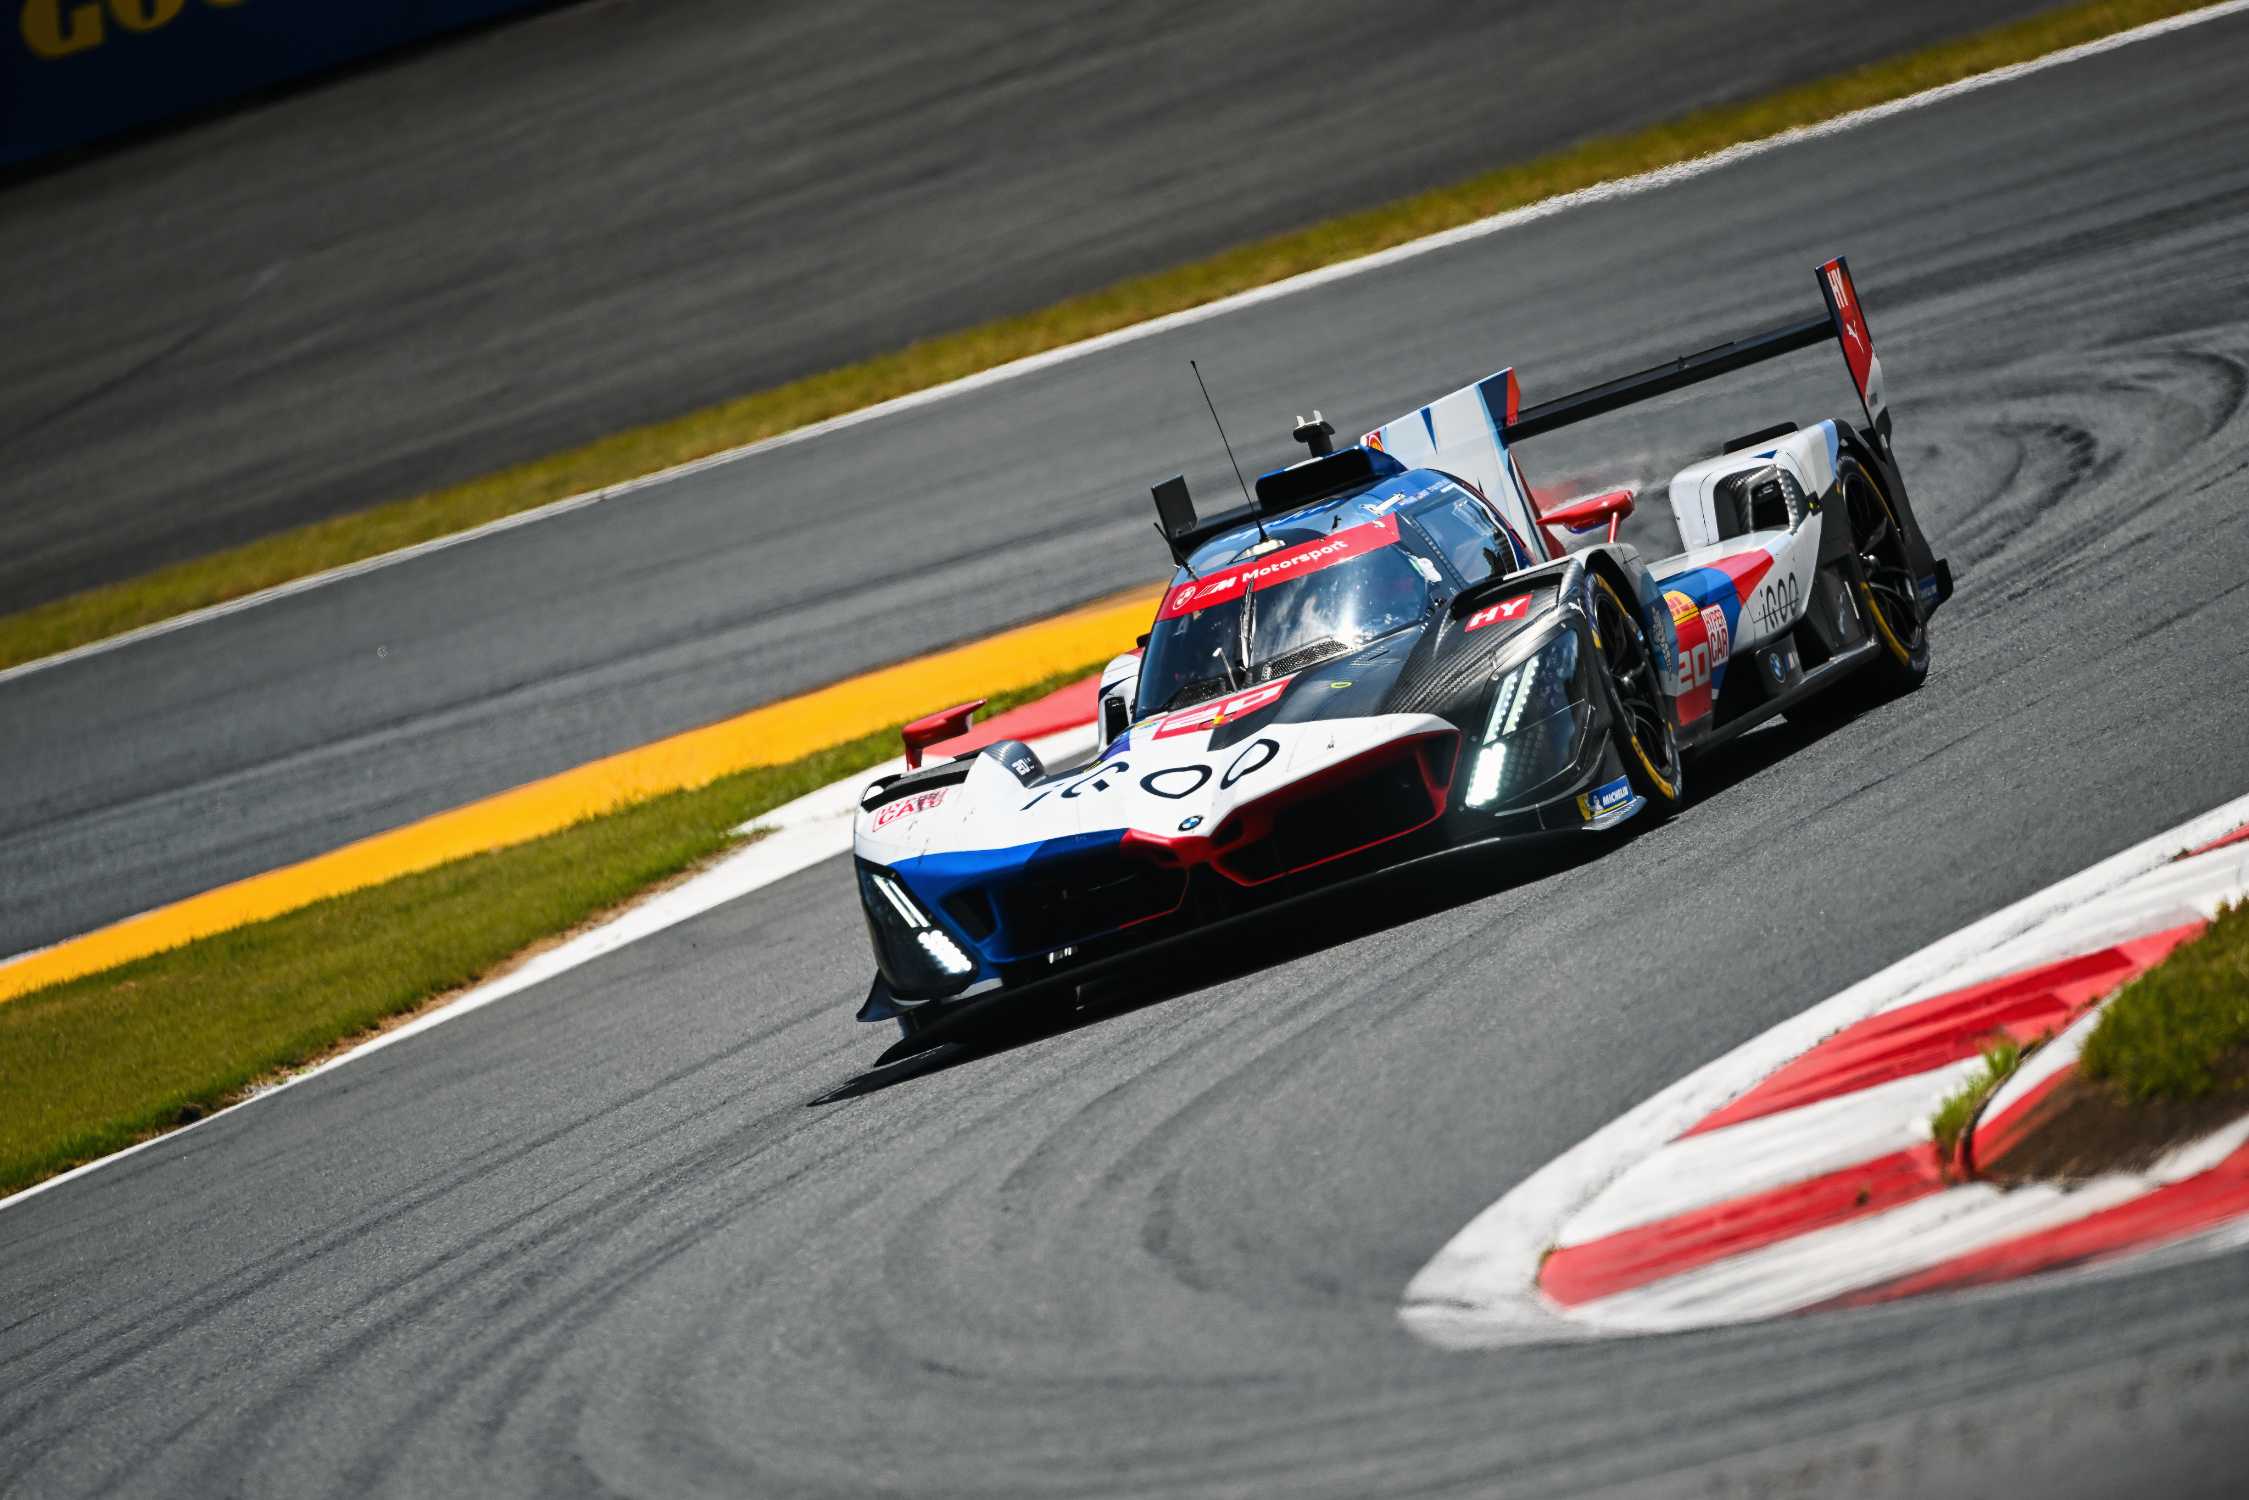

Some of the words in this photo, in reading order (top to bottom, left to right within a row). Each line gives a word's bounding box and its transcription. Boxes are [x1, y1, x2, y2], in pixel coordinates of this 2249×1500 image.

[1242, 540, 1349, 582] Motorsport
[1469, 598, 1527, 627] HY
[1709, 627, 1729, 662] CAR
[1678, 641, 1711, 694] 20
[1602, 786, 1629, 807] MICHELIN
